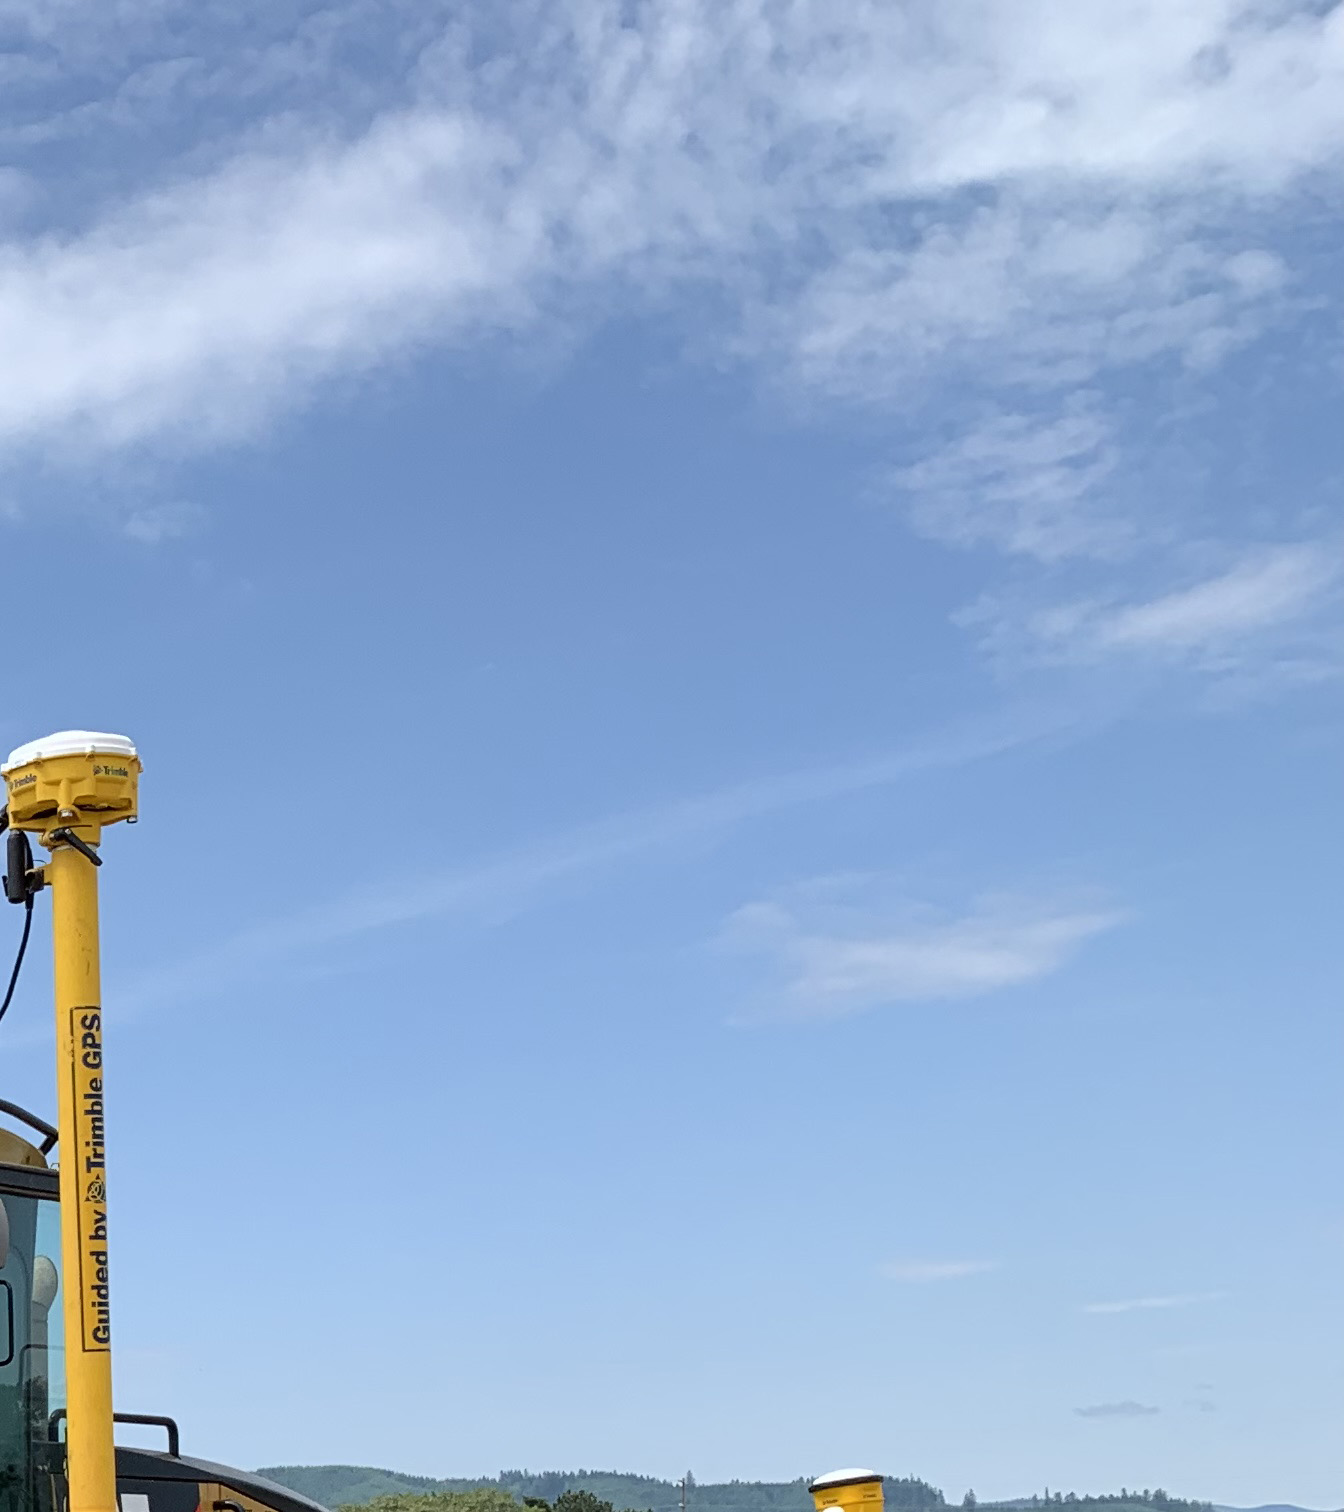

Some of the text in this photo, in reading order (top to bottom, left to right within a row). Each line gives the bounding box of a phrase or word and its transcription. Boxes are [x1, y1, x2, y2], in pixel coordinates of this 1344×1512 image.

[103, 765, 129, 777] Trimble
[80, 1013, 102, 1070] GPS
[84, 1077, 106, 1174] Trimble
[90, 1251, 111, 1344] Guided
